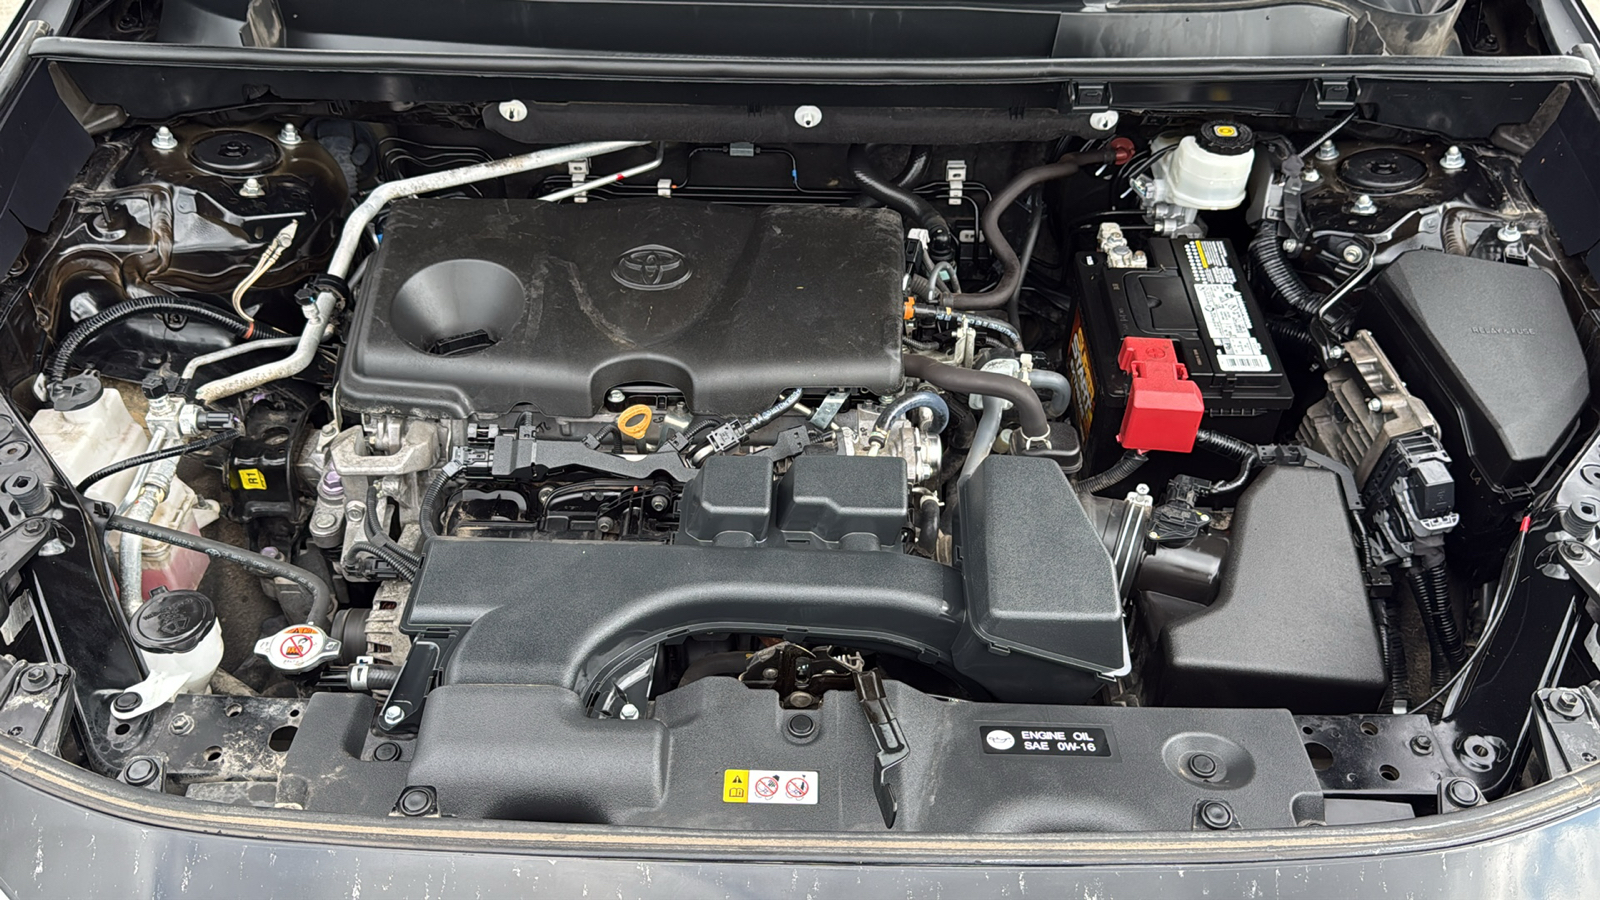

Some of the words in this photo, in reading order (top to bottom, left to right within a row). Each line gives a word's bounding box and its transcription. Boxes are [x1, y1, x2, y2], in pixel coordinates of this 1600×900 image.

[246, 472, 259, 484] R1
[1021, 730, 1067, 741] ENGINE
[1072, 731, 1094, 742] OIL
[1023, 741, 1050, 751] SAE
[1056, 741, 1097, 752] 0W-16
